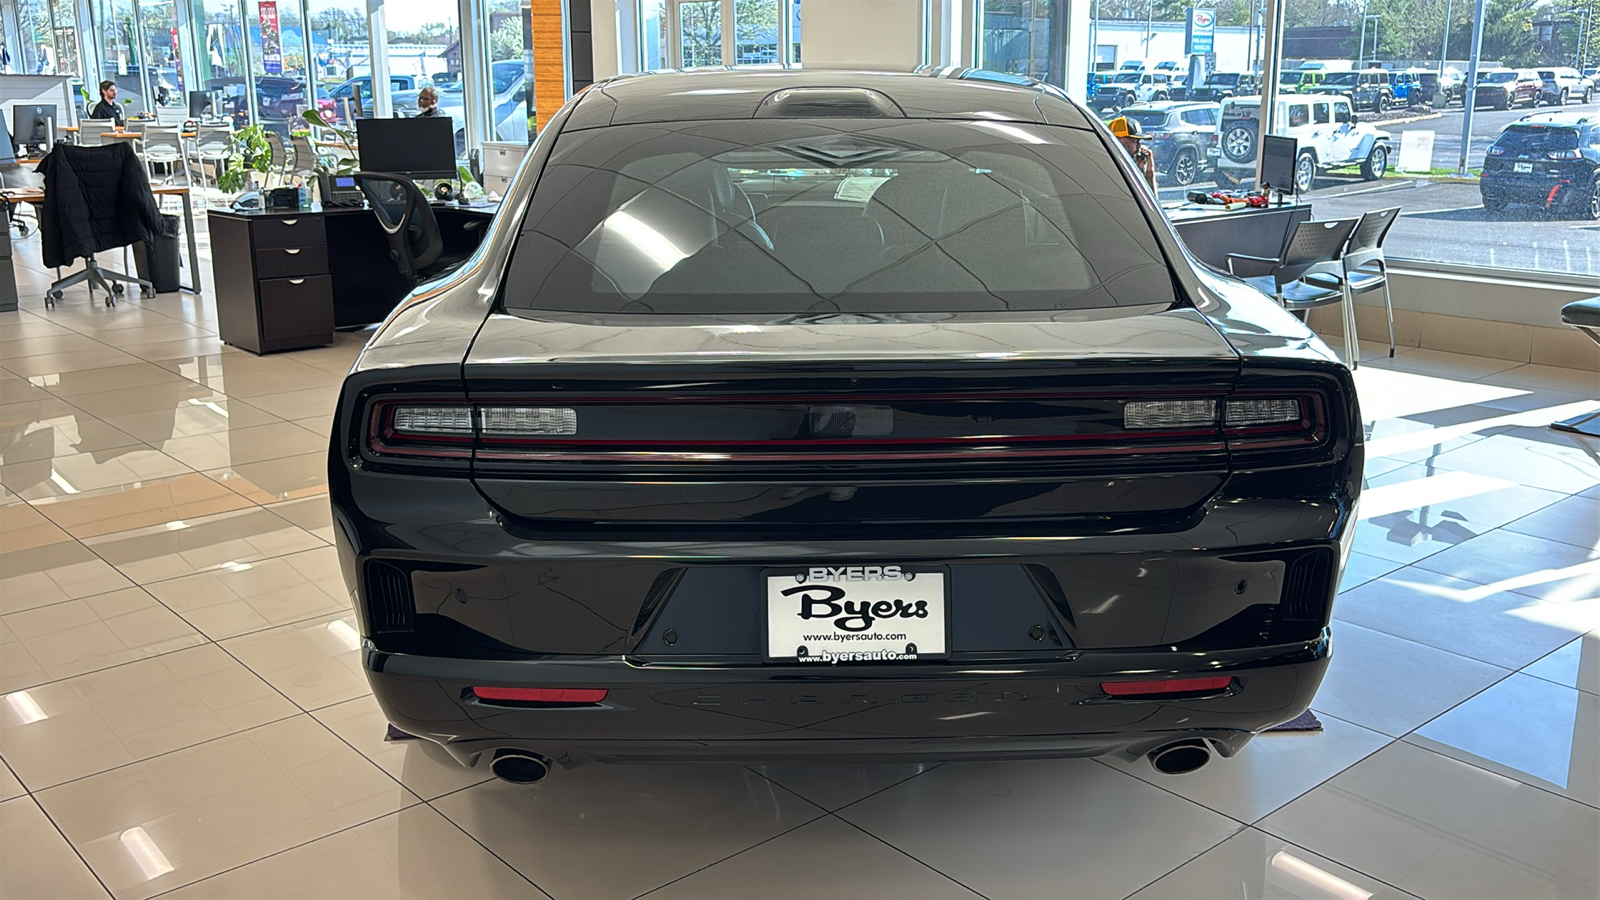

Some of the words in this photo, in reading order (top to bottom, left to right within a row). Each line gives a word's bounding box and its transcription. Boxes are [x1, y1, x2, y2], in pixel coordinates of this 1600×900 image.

[1206, 62, 1215, 70] 35
[808, 565, 902, 582] BYERS
[780, 584, 929, 632] Byers
[802, 631, 907, 643] www.byersauto.com
[798, 649, 918, 664] www.byersauto.com
